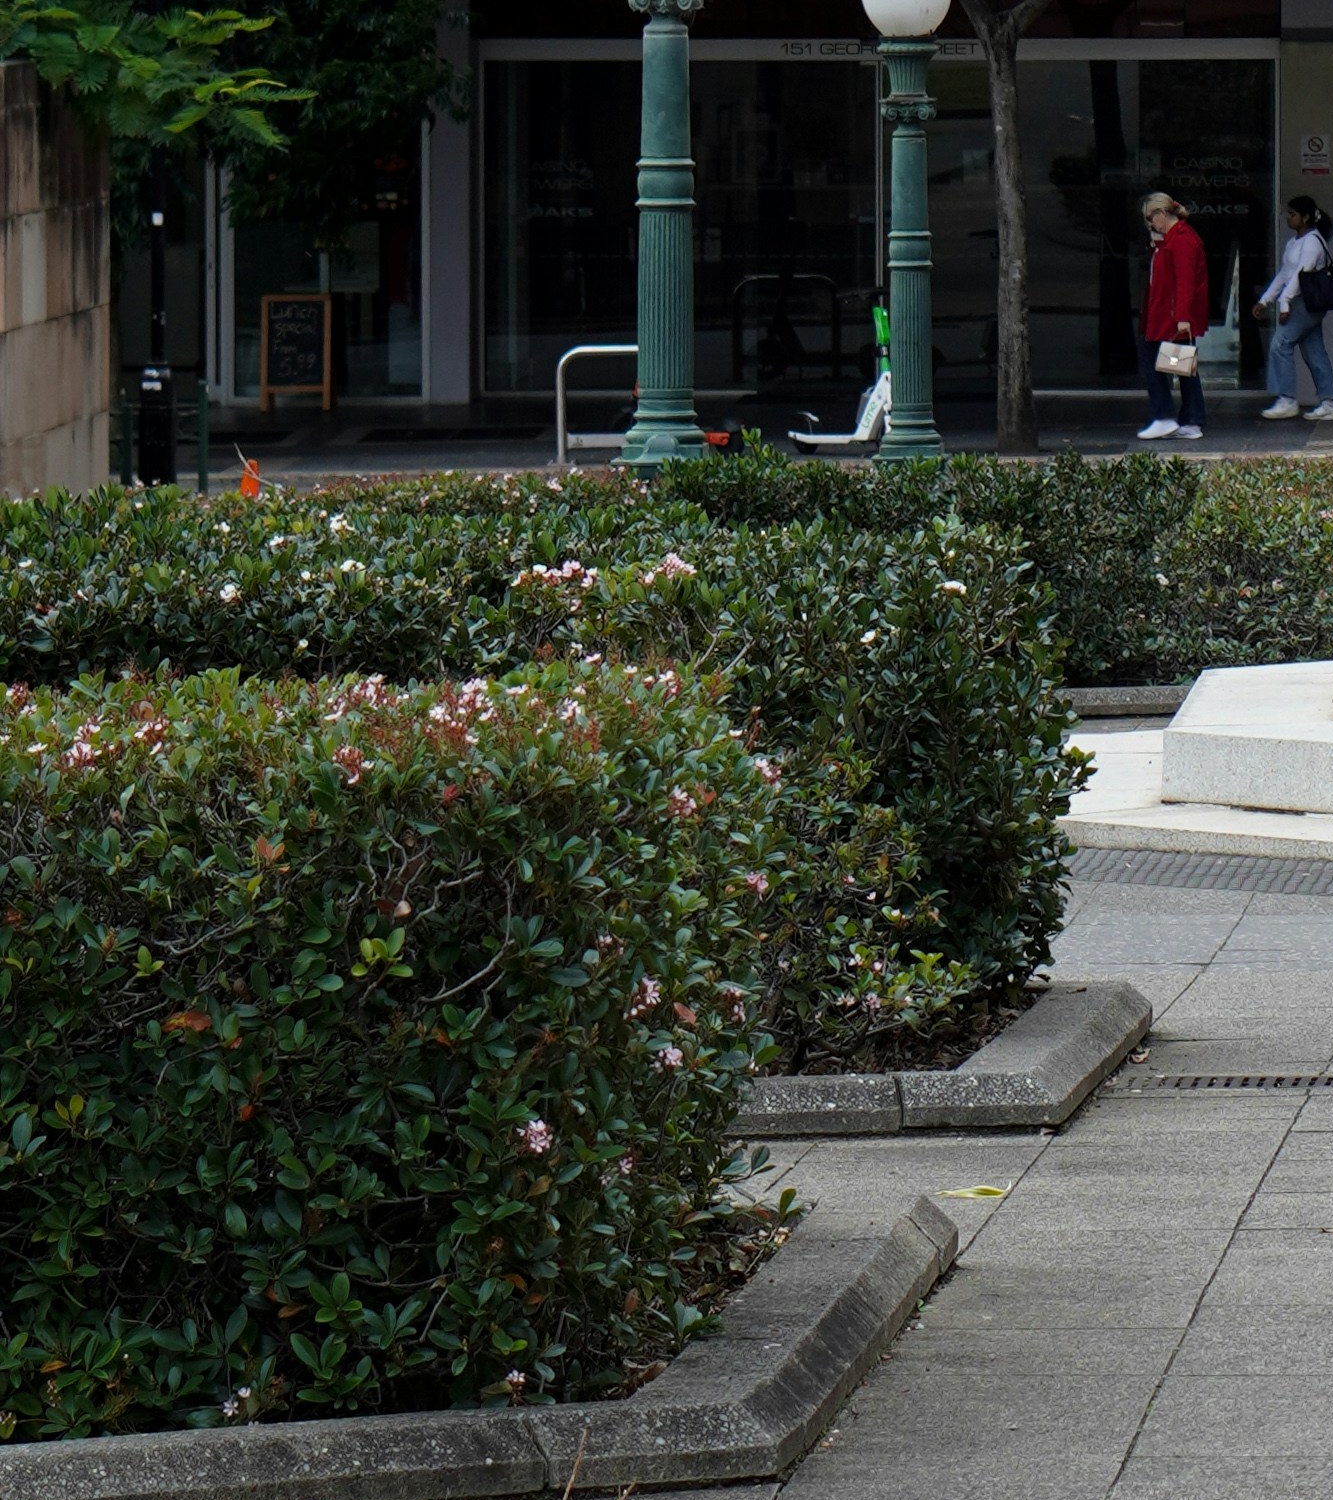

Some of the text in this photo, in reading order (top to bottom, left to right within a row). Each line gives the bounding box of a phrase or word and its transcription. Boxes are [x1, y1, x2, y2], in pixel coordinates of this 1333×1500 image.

[781, 43, 812, 56] 151
[819, 43, 879, 56] GEOR
[1173, 157, 1243, 169] CASINO
[1169, 175, 1249, 187] TOWERS
[271, 302, 318, 319] Lunch
